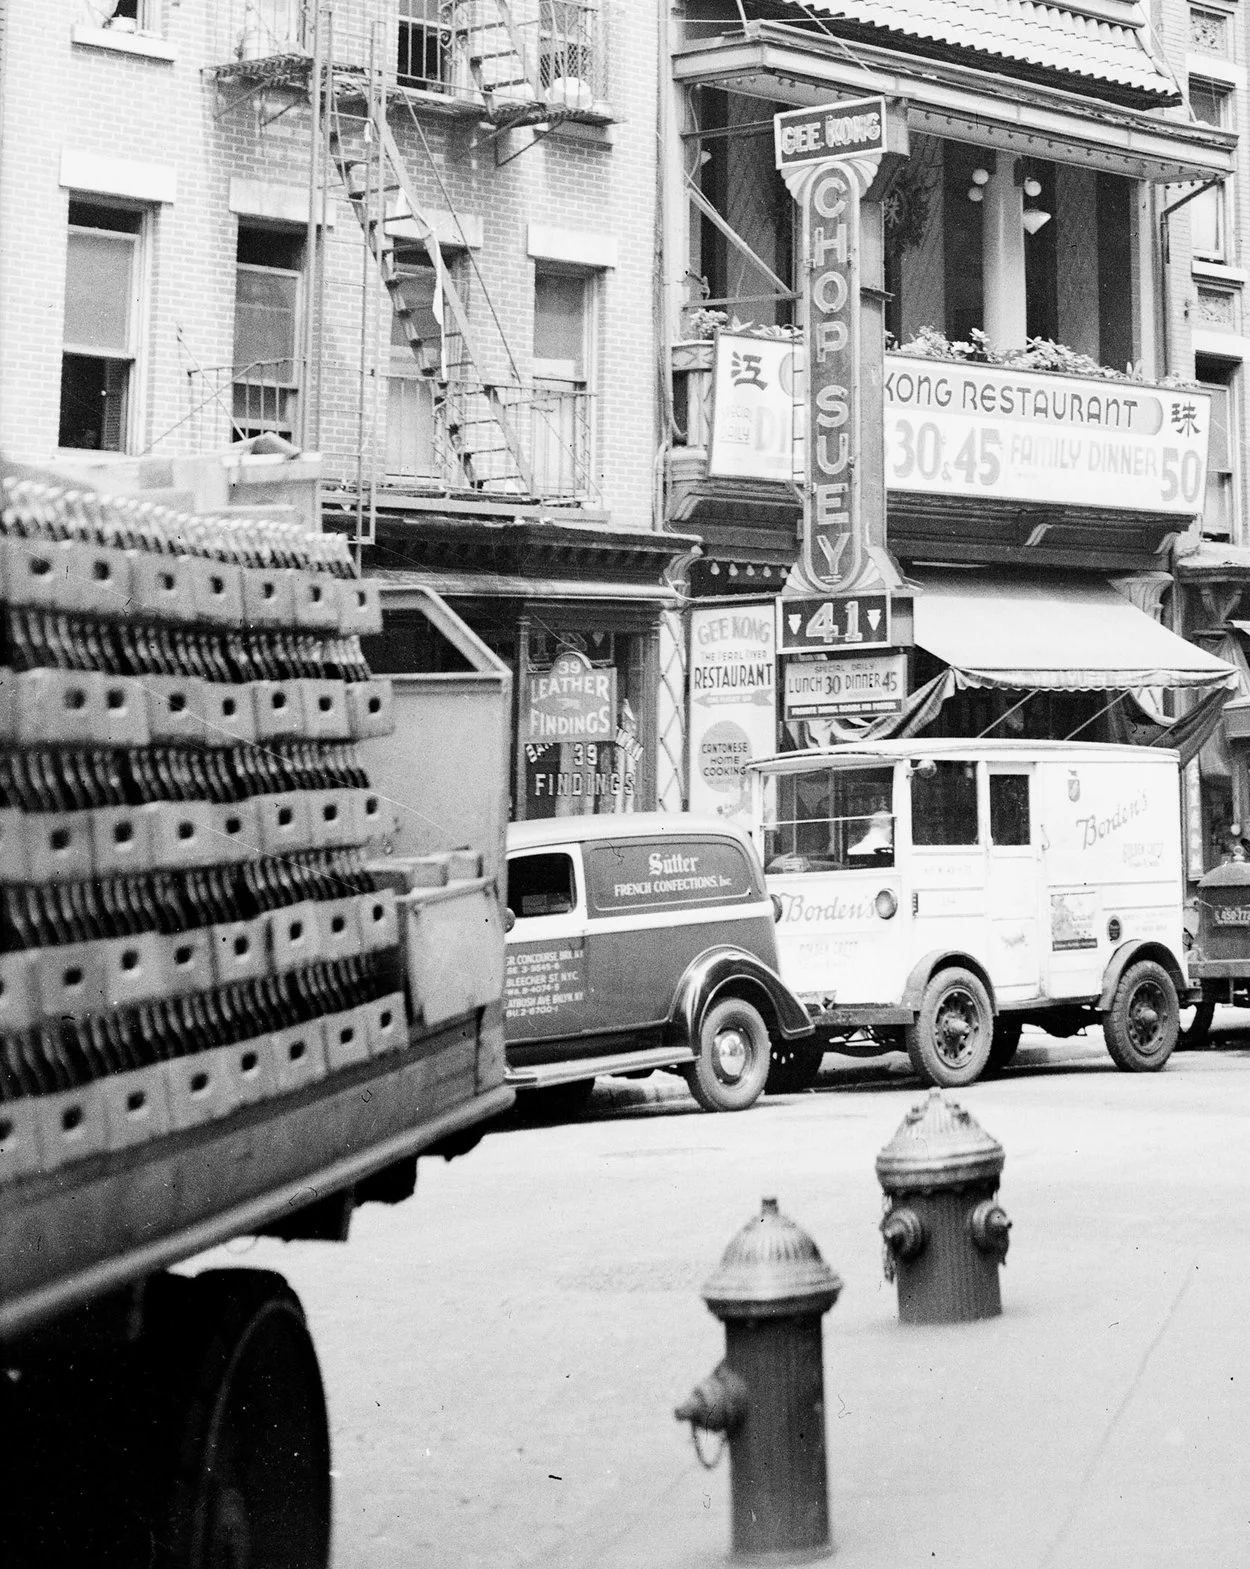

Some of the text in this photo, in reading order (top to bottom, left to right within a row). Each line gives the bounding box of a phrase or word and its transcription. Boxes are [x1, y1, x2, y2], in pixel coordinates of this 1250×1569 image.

[781, 112, 880, 155] GEE KONG
[813, 178, 850, 576] CHOP SUEY
[963, 381, 1138, 428] RESTAURANT
[1011, 433, 1082, 470] FAMILY
[1088, 440, 1157, 477] DINNER
[1160, 447, 1201, 503] 50
[697, 615, 771, 645] GEE KONG
[806, 600, 863, 644] 41
[558, 661, 582, 674] 39
[694, 663, 773, 690] RESTAURANT
[530, 675, 610, 704] LEATHER
[789, 671, 898, 695] LUNCH 30 DINNER 45
[530, 706, 610, 736] FINDINGS
[574, 743, 598, 766] 39
[702, 742, 748, 754] CANTONESE
[711, 755, 740, 765] HOME
[535, 773, 635, 796] FINDINGS
[703, 765, 747, 777] COOKING
[1075, 790, 1149, 850] Borden's
[614, 881, 652, 897] FRENCH
